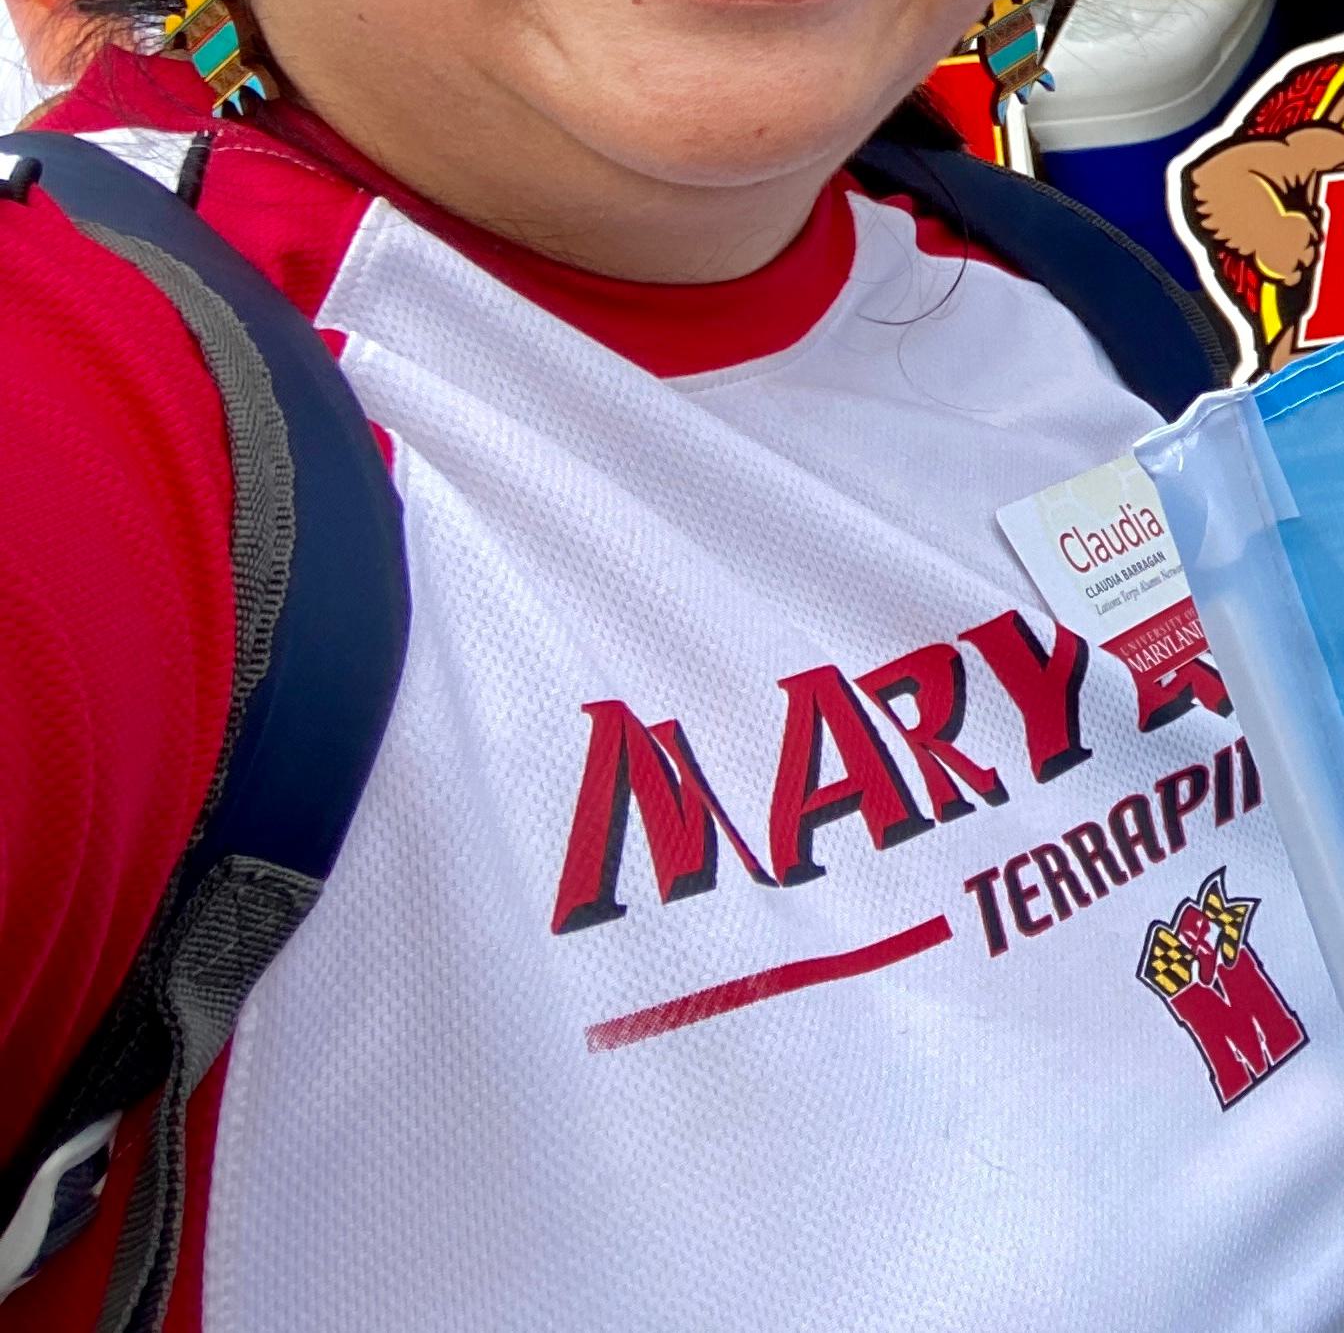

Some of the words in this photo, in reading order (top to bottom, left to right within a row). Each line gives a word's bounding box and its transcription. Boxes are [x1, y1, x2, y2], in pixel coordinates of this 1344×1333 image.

[1059, 503, 1164, 573] Claudia
[1085, 572, 1123, 599] CLAUDIA
[1121, 551, 1166, 581] BARRAGAN
[1119, 615, 1182, 656] UNIVERSITY
[551, 610, 1200, 934] MARY
[1158, 919, 1310, 1112] M
